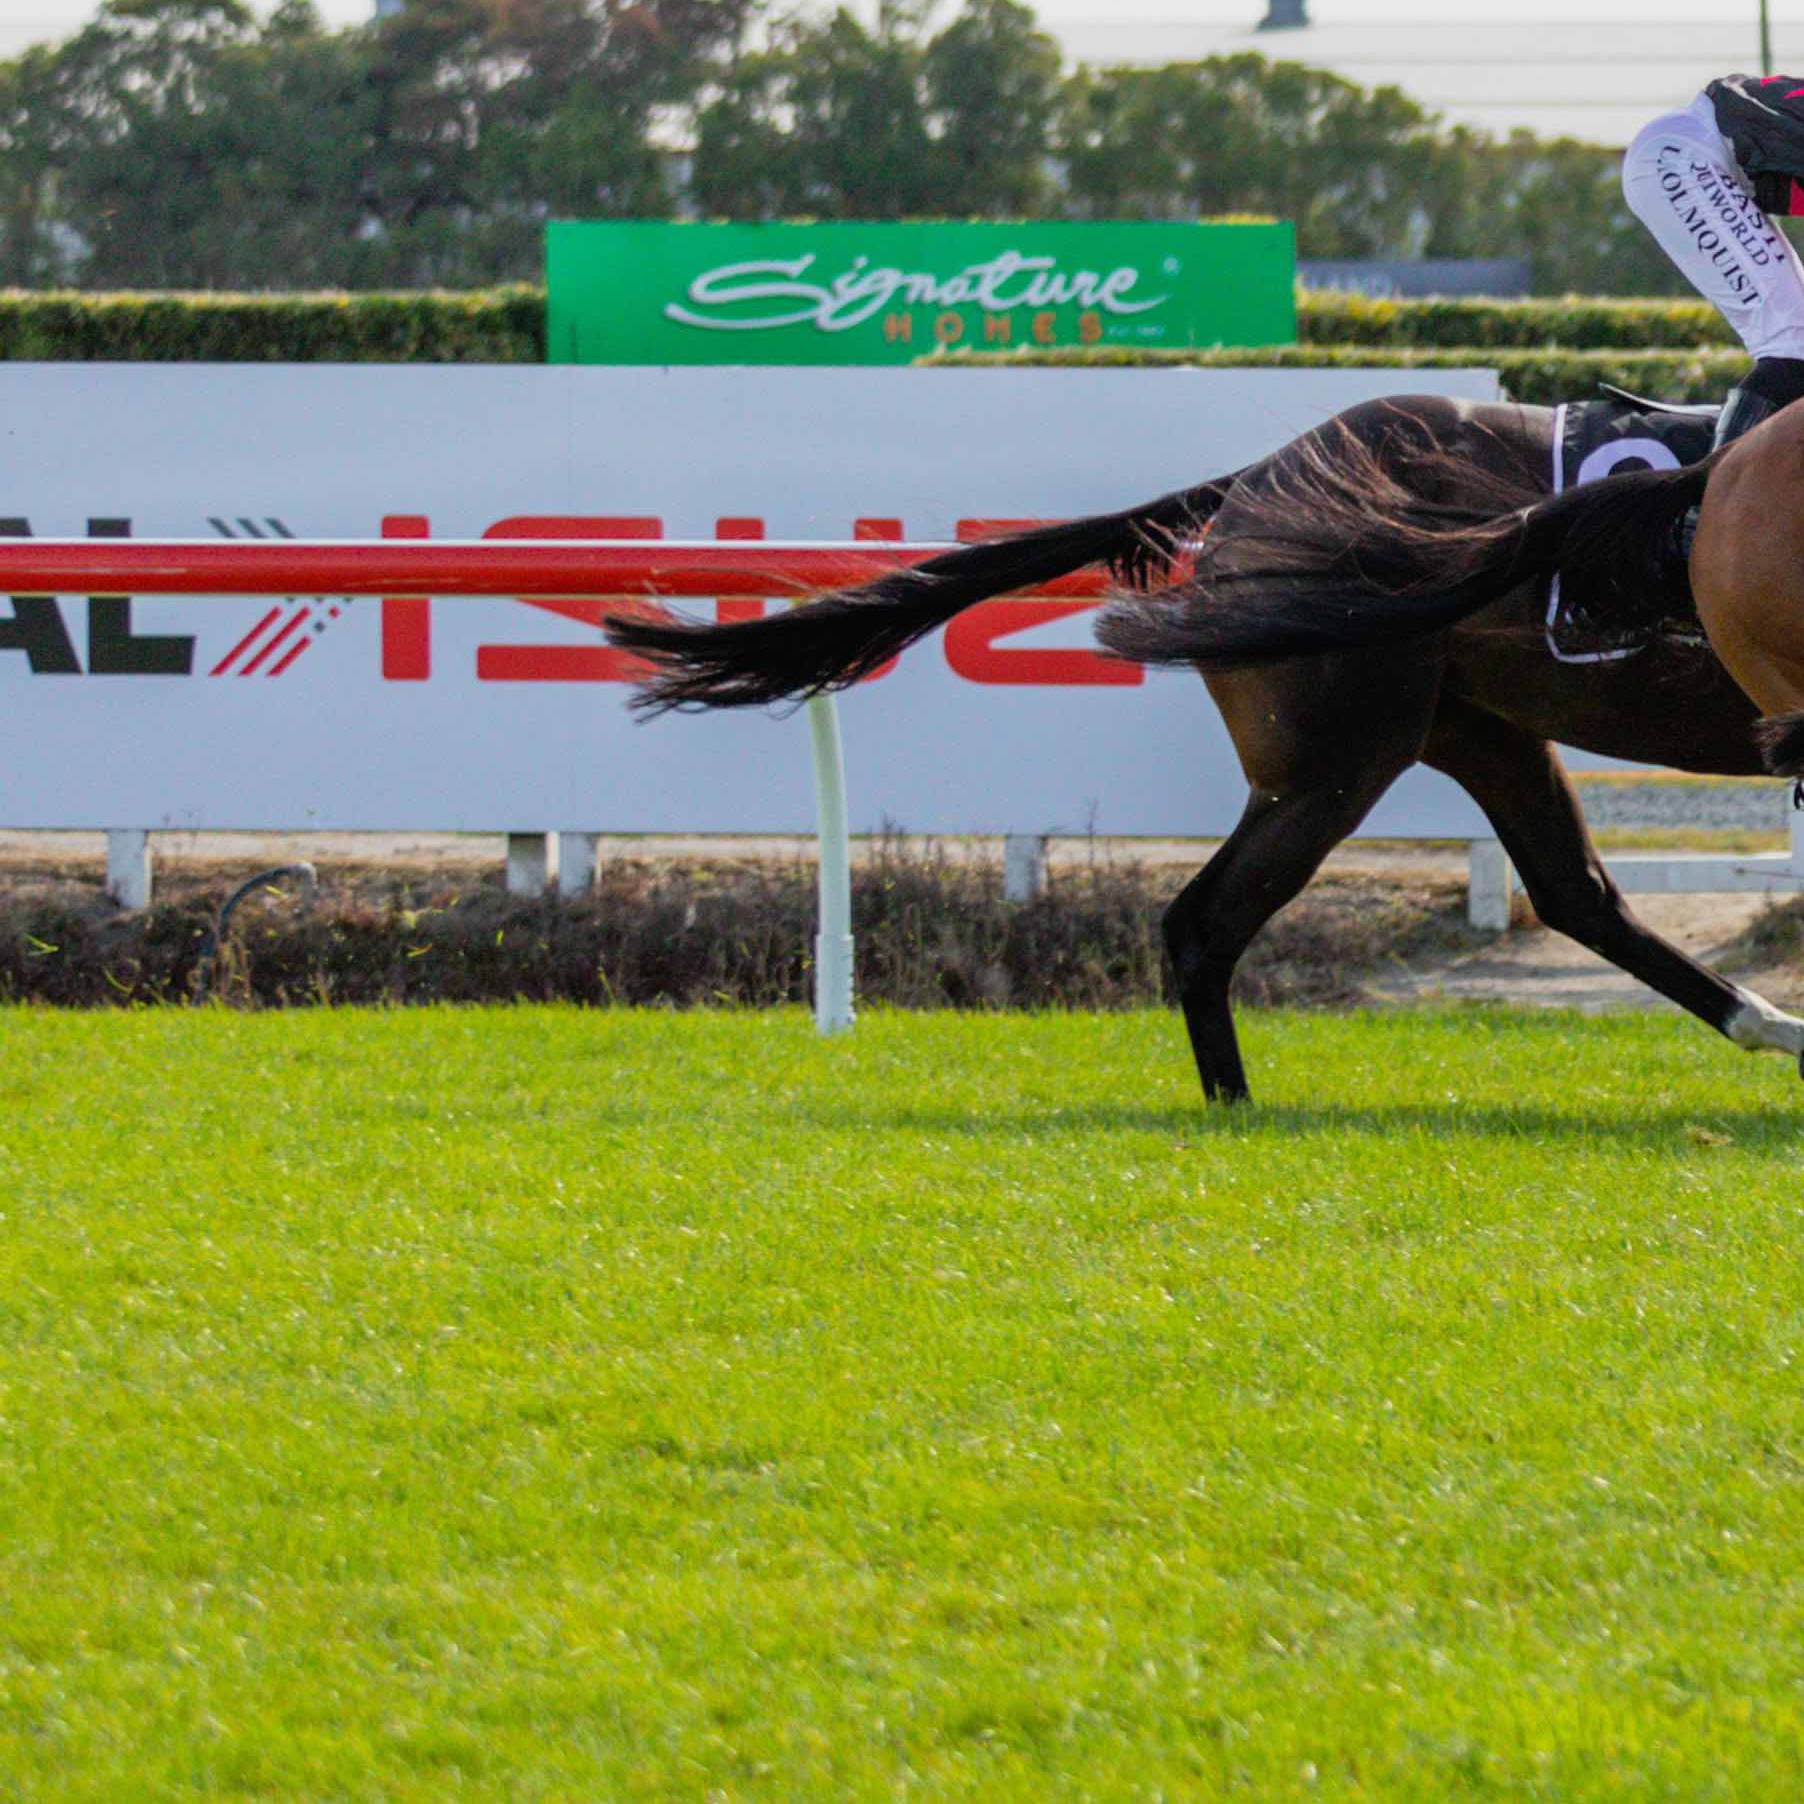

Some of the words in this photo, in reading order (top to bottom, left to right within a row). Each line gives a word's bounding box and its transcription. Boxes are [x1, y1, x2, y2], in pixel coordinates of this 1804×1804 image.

[1690, 162, 1770, 266] QUIWORLD
[664, 250, 1172, 330] Signature
[883, 311, 1102, 343] HOMES
